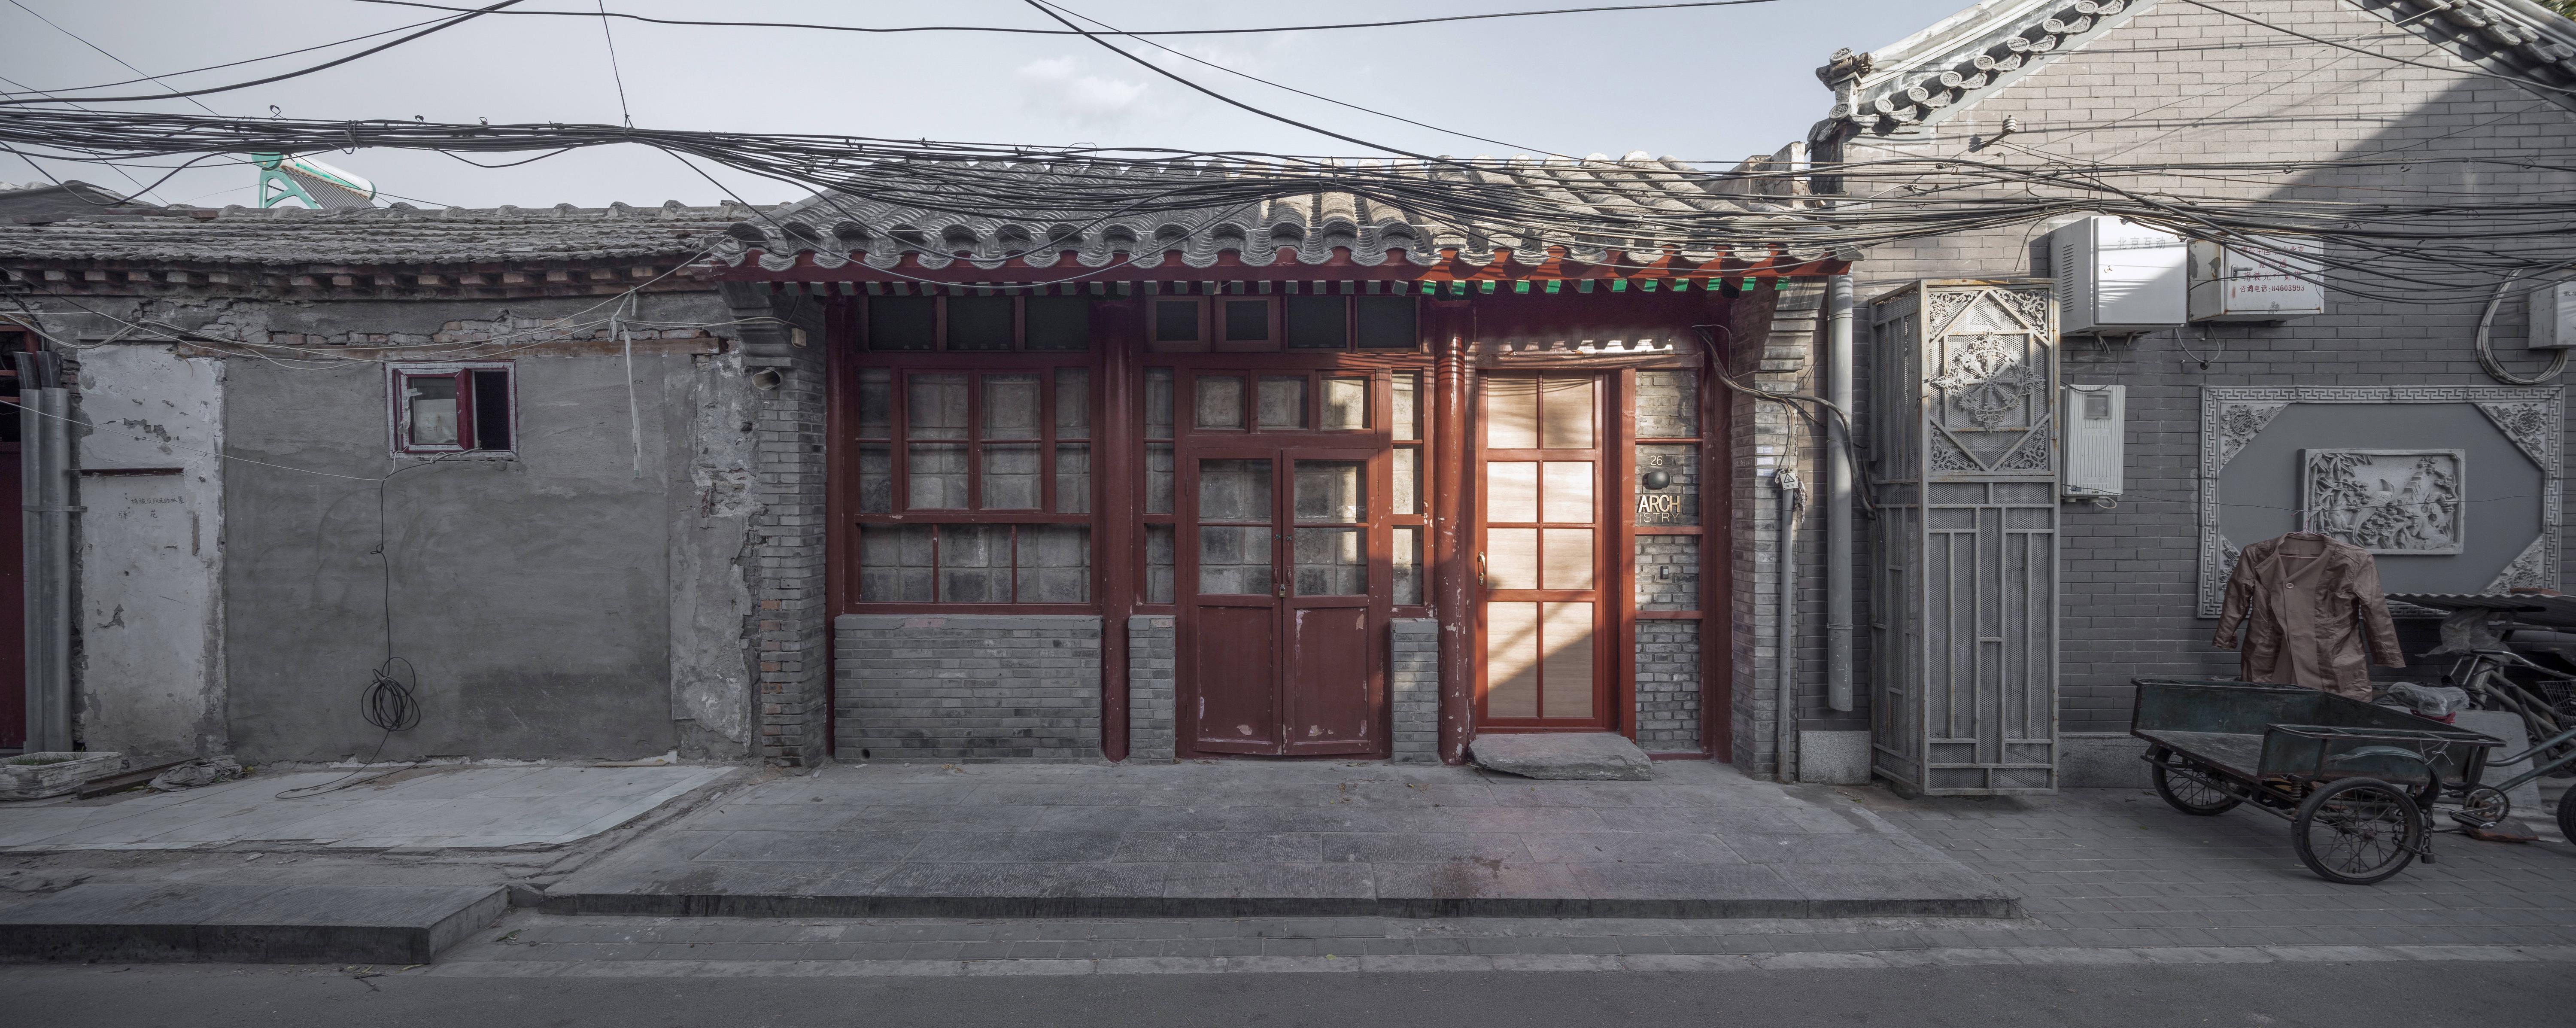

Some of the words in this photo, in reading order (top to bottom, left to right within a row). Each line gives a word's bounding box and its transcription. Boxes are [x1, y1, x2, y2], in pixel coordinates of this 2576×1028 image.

[2117, 236, 2166, 249] 北京互动
[1650, 455, 1663, 465] 26
[1638, 494, 1680, 513] ARCH
[1639, 513, 1680, 523] ISTRY
